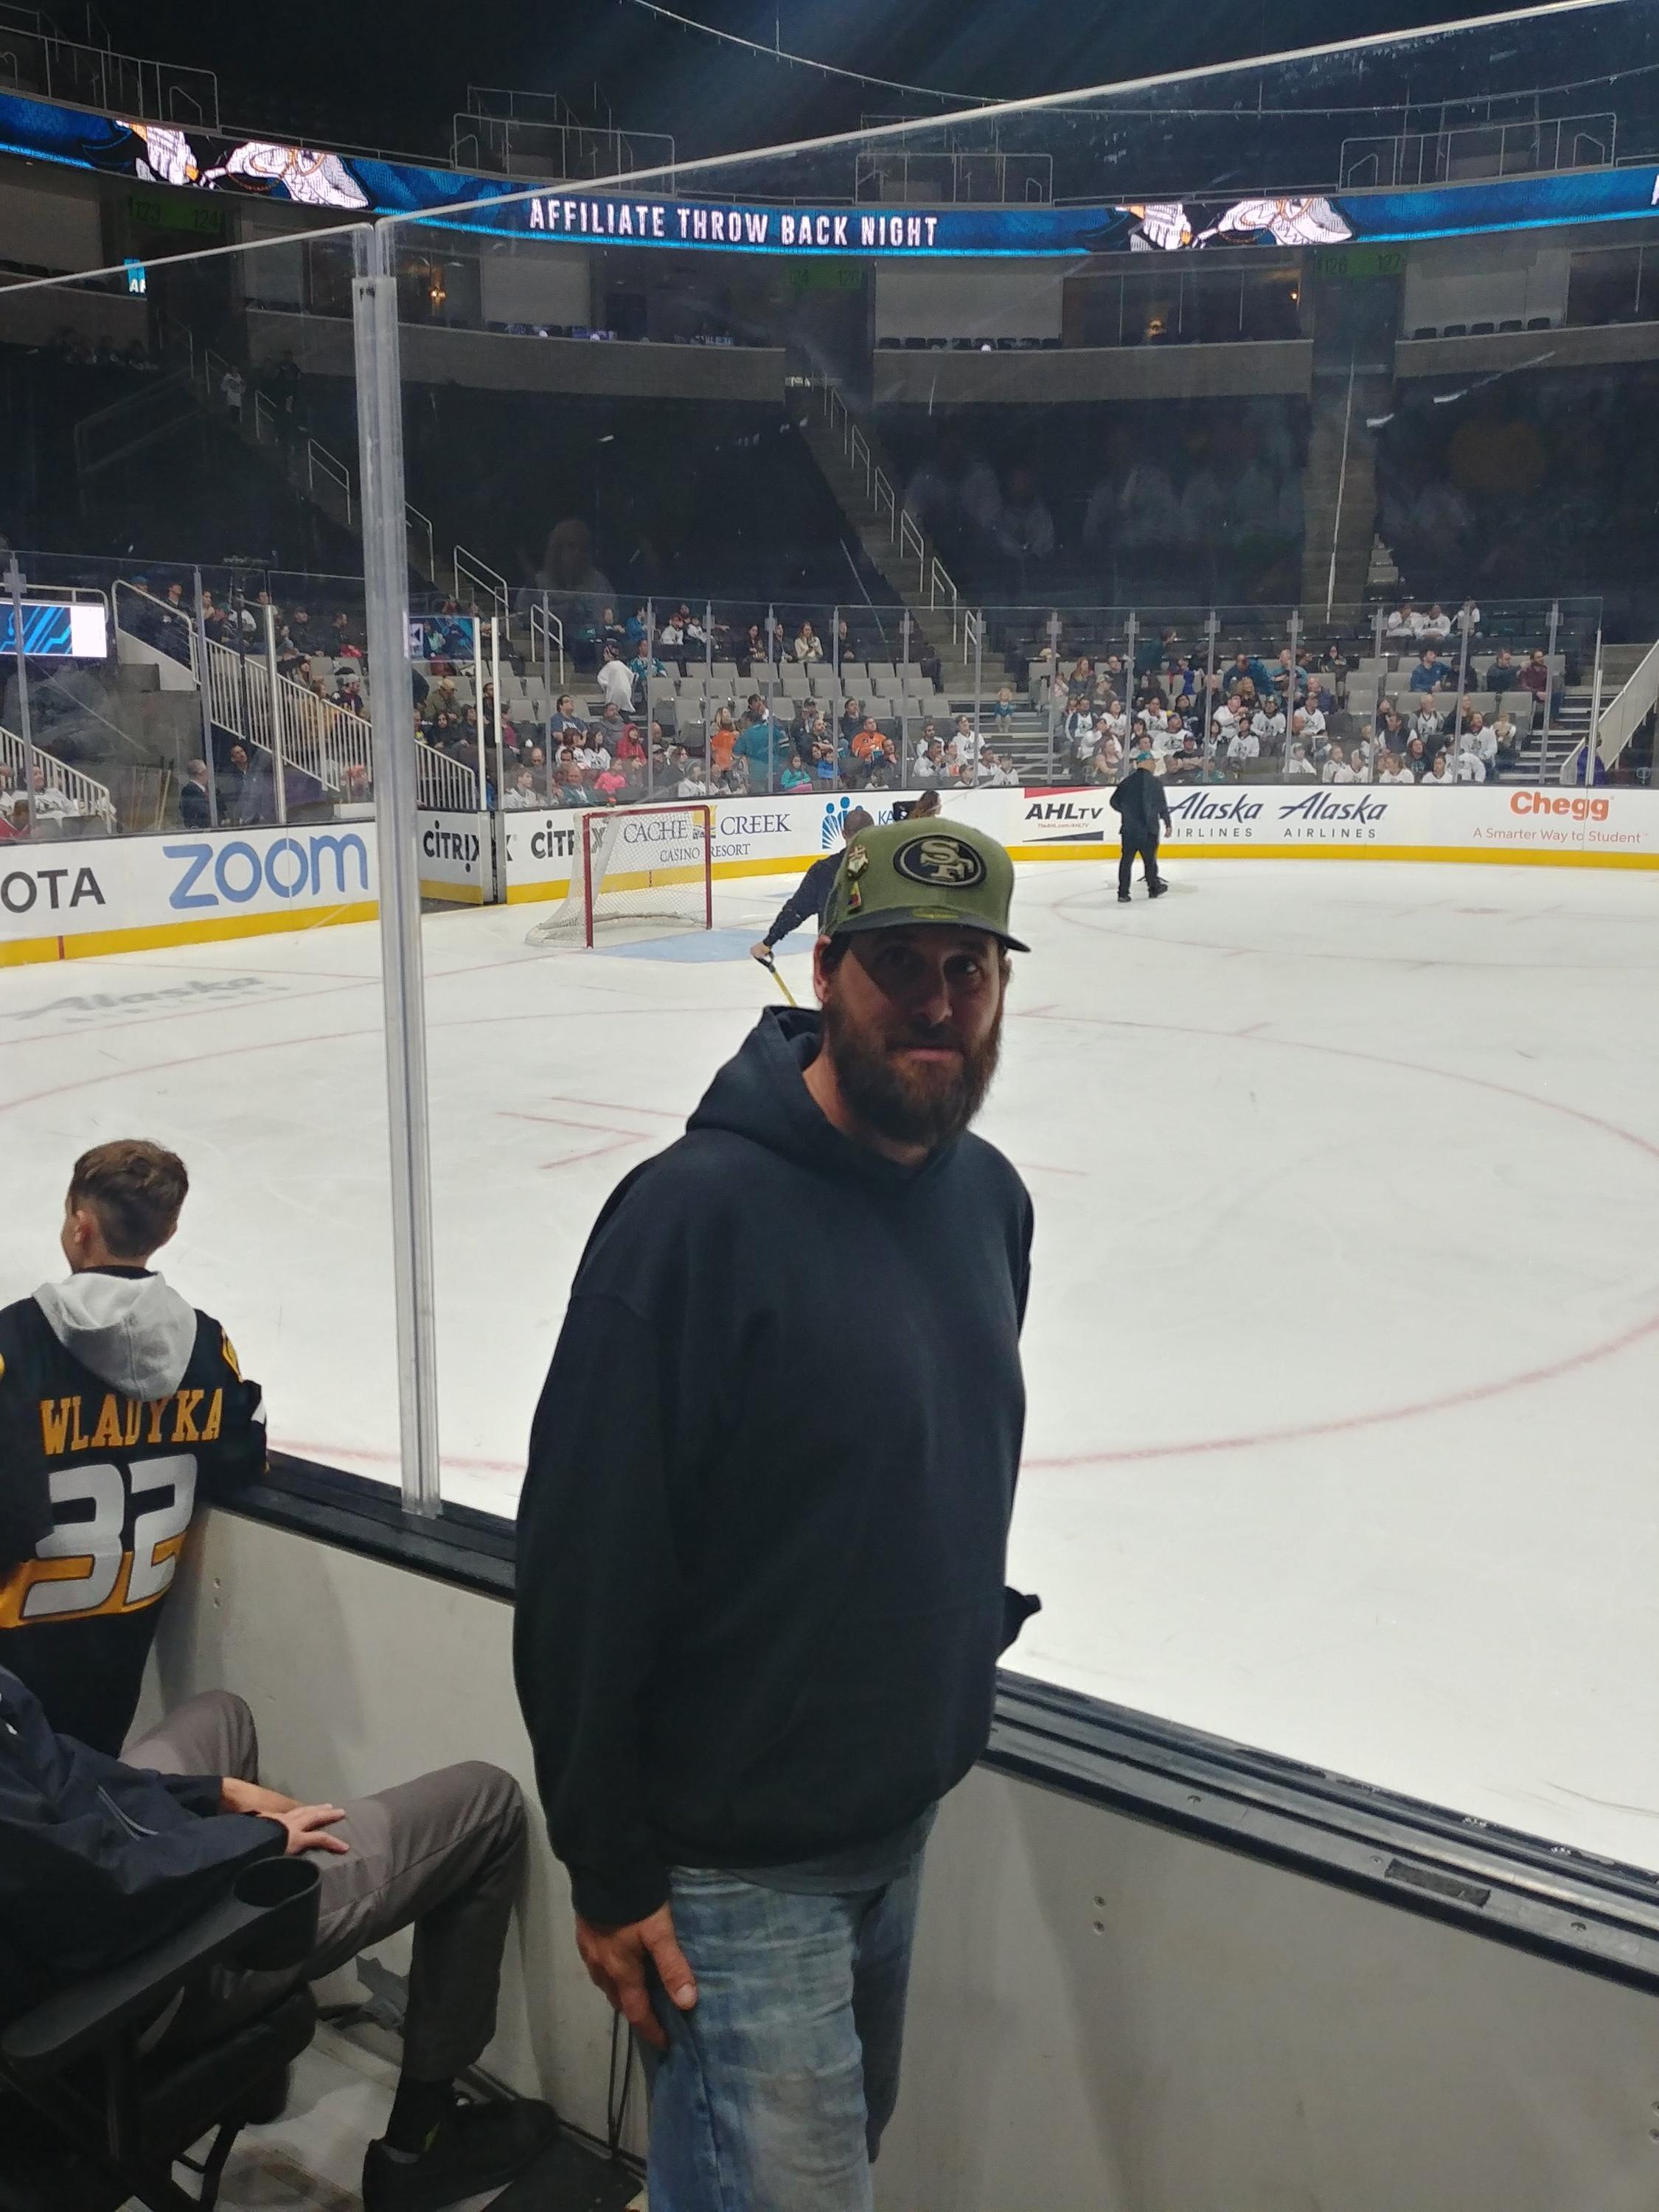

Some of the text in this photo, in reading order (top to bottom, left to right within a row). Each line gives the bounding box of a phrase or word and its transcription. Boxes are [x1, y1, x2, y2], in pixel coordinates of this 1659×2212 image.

[529, 198, 937, 246] AFFILIATE THROW BACK NIGHT
[1168, 791, 1264, 823] Alaska
[1279, 791, 1388, 824] Alaska
[1511, 790, 1610, 821] Chegg
[624, 820, 689, 844] CACHE
[720, 813, 792, 836] CREEK
[1177, 828, 1253, 838] IRLINES
[1284, 828, 1376, 838] AIRLINES
[1473, 827, 1641, 844] A Smarter Way to Student
[660, 847, 700, 862] CASINO
[162, 832, 369, 910] zoom
[40, 1388, 224, 1456] WLADYKA
[21, 1453, 198, 1618] 32
